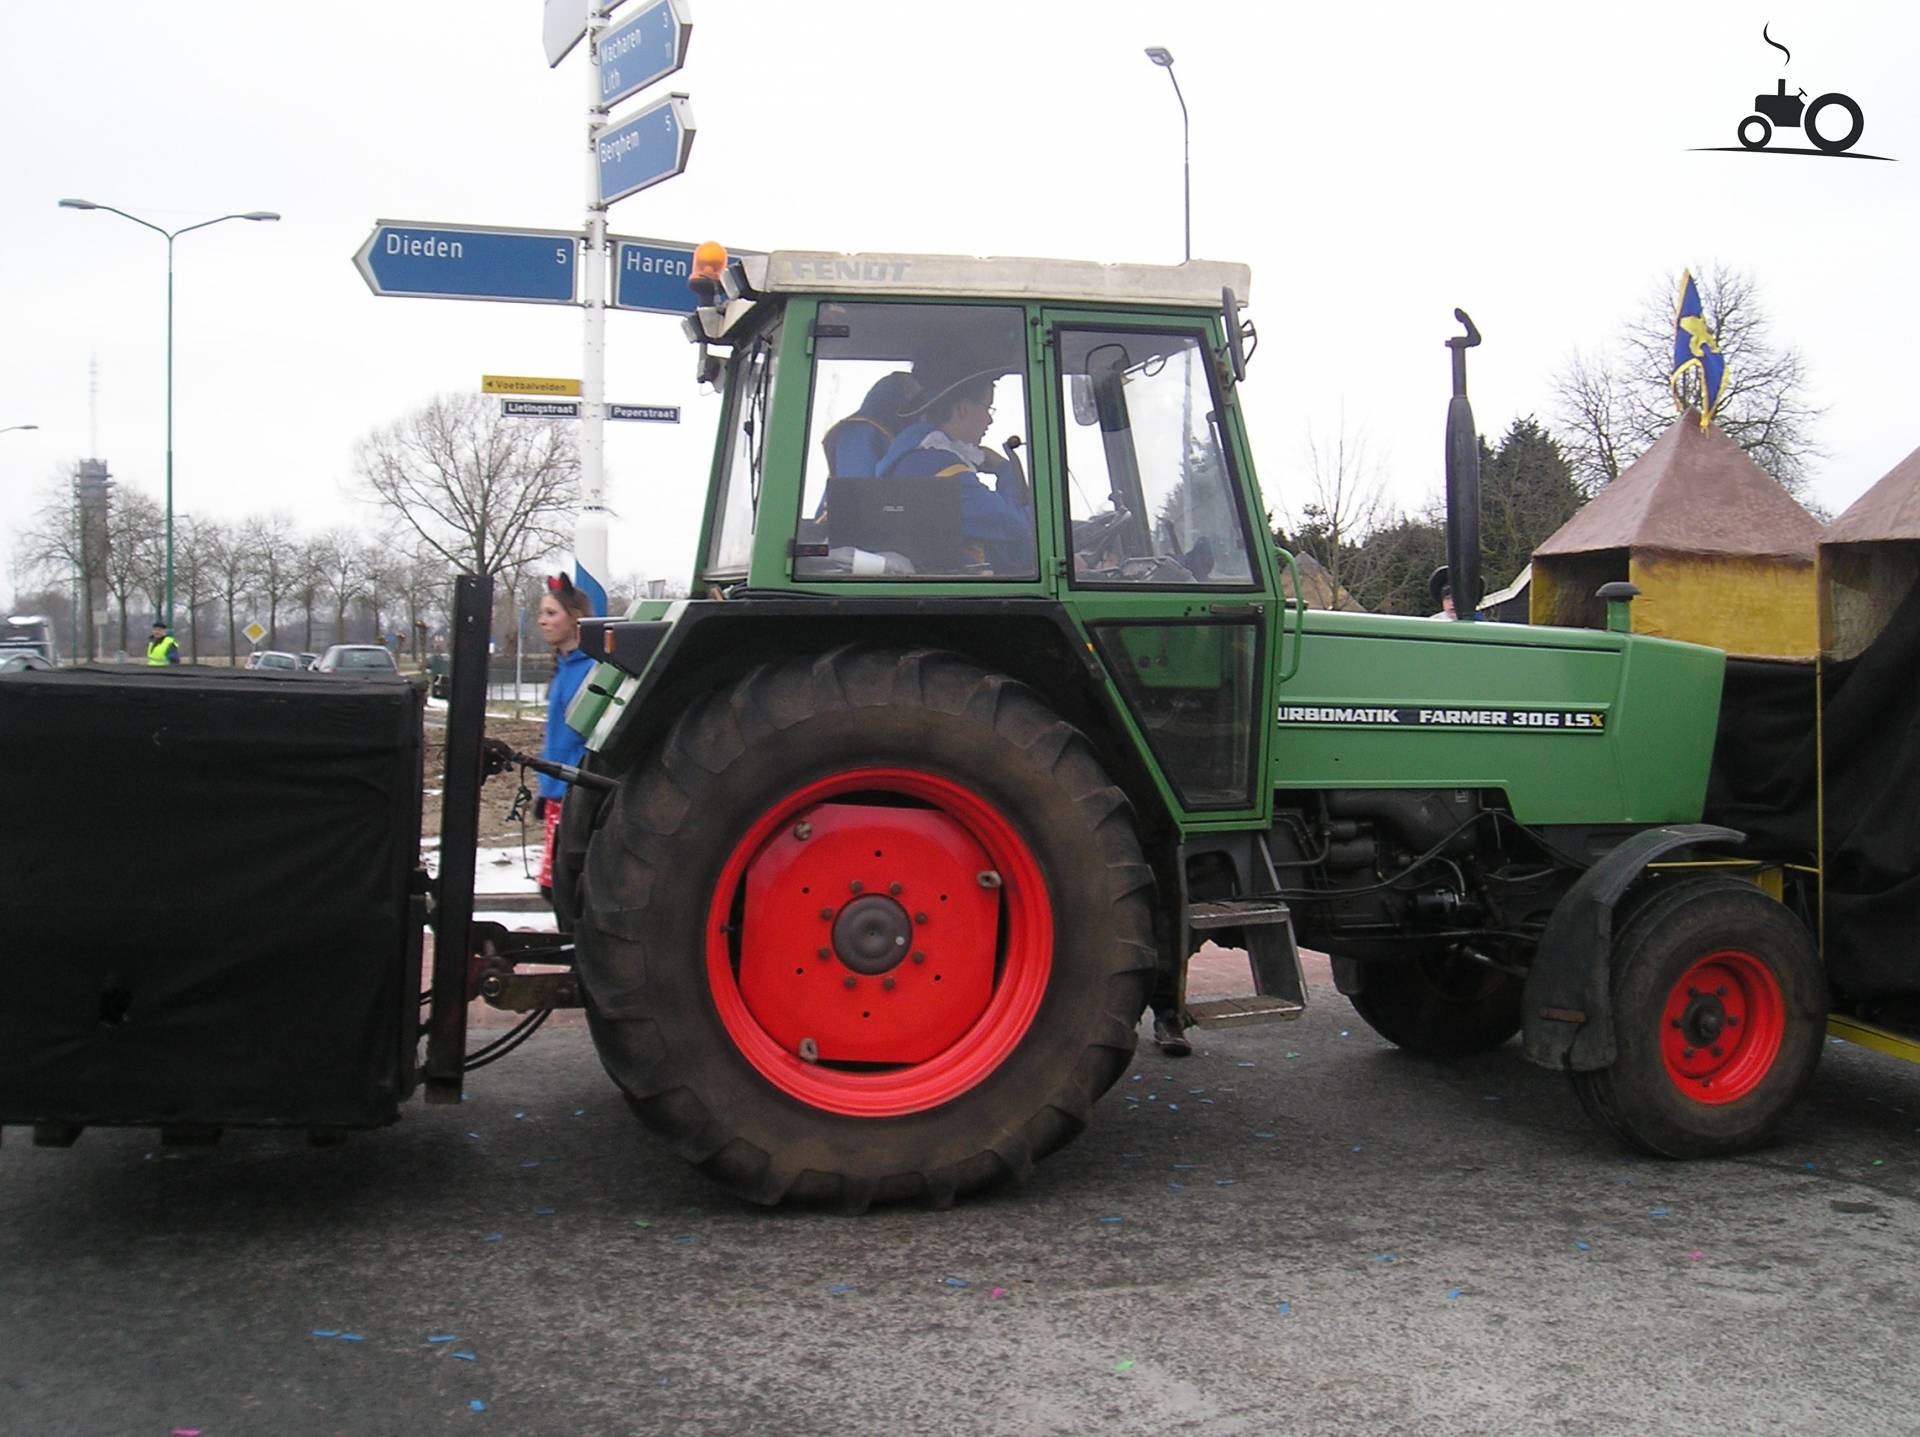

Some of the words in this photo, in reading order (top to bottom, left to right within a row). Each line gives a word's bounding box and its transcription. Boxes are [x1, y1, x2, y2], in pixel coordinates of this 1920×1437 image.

[603, 67, 621, 94] Lith
[600, 131, 640, 162] Berghem
[664, 114, 672, 132] 5
[386, 233, 464, 258] Dieden
[555, 248, 567, 264] 5
[626, 250, 687, 277] Haren
[789, 259, 912, 282] FENDT
[495, 381, 567, 392] Voetbalvelden
[613, 406, 676, 419] Peperstraat
[1278, 706, 1400, 723] URBOMATIK
[1419, 709, 1507, 725] FARMER
[1512, 712, 1559, 727] 306
[1564, 713, 1604, 727] LSX
